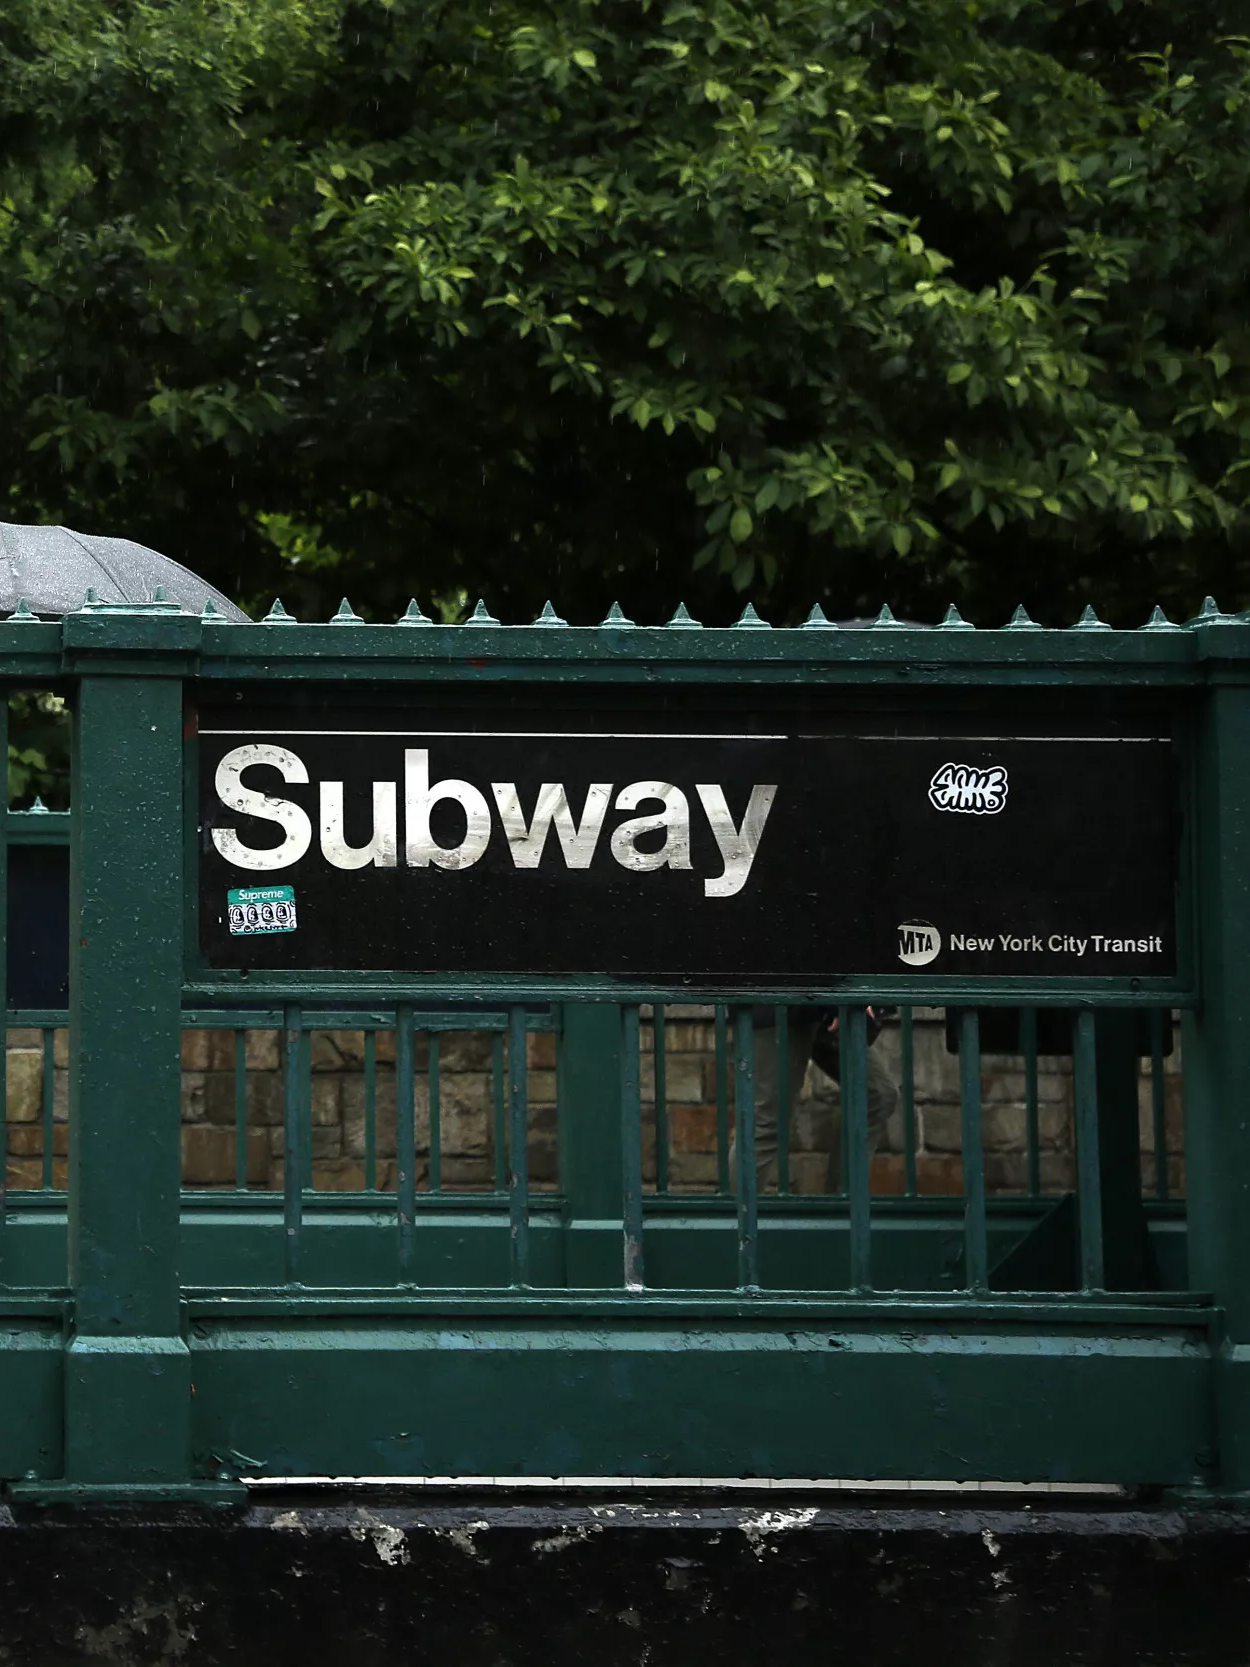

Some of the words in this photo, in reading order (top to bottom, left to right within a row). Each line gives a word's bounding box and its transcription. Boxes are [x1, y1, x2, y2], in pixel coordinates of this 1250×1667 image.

[211, 743, 778, 897] Subway
[238, 889, 284, 902] Supreme
[898, 927, 934, 956] MTA
[950, 934, 995, 952] New
[999, 934, 1043, 952] York
[1048, 934, 1088, 956] City
[1091, 935, 1163, 953] Transit
